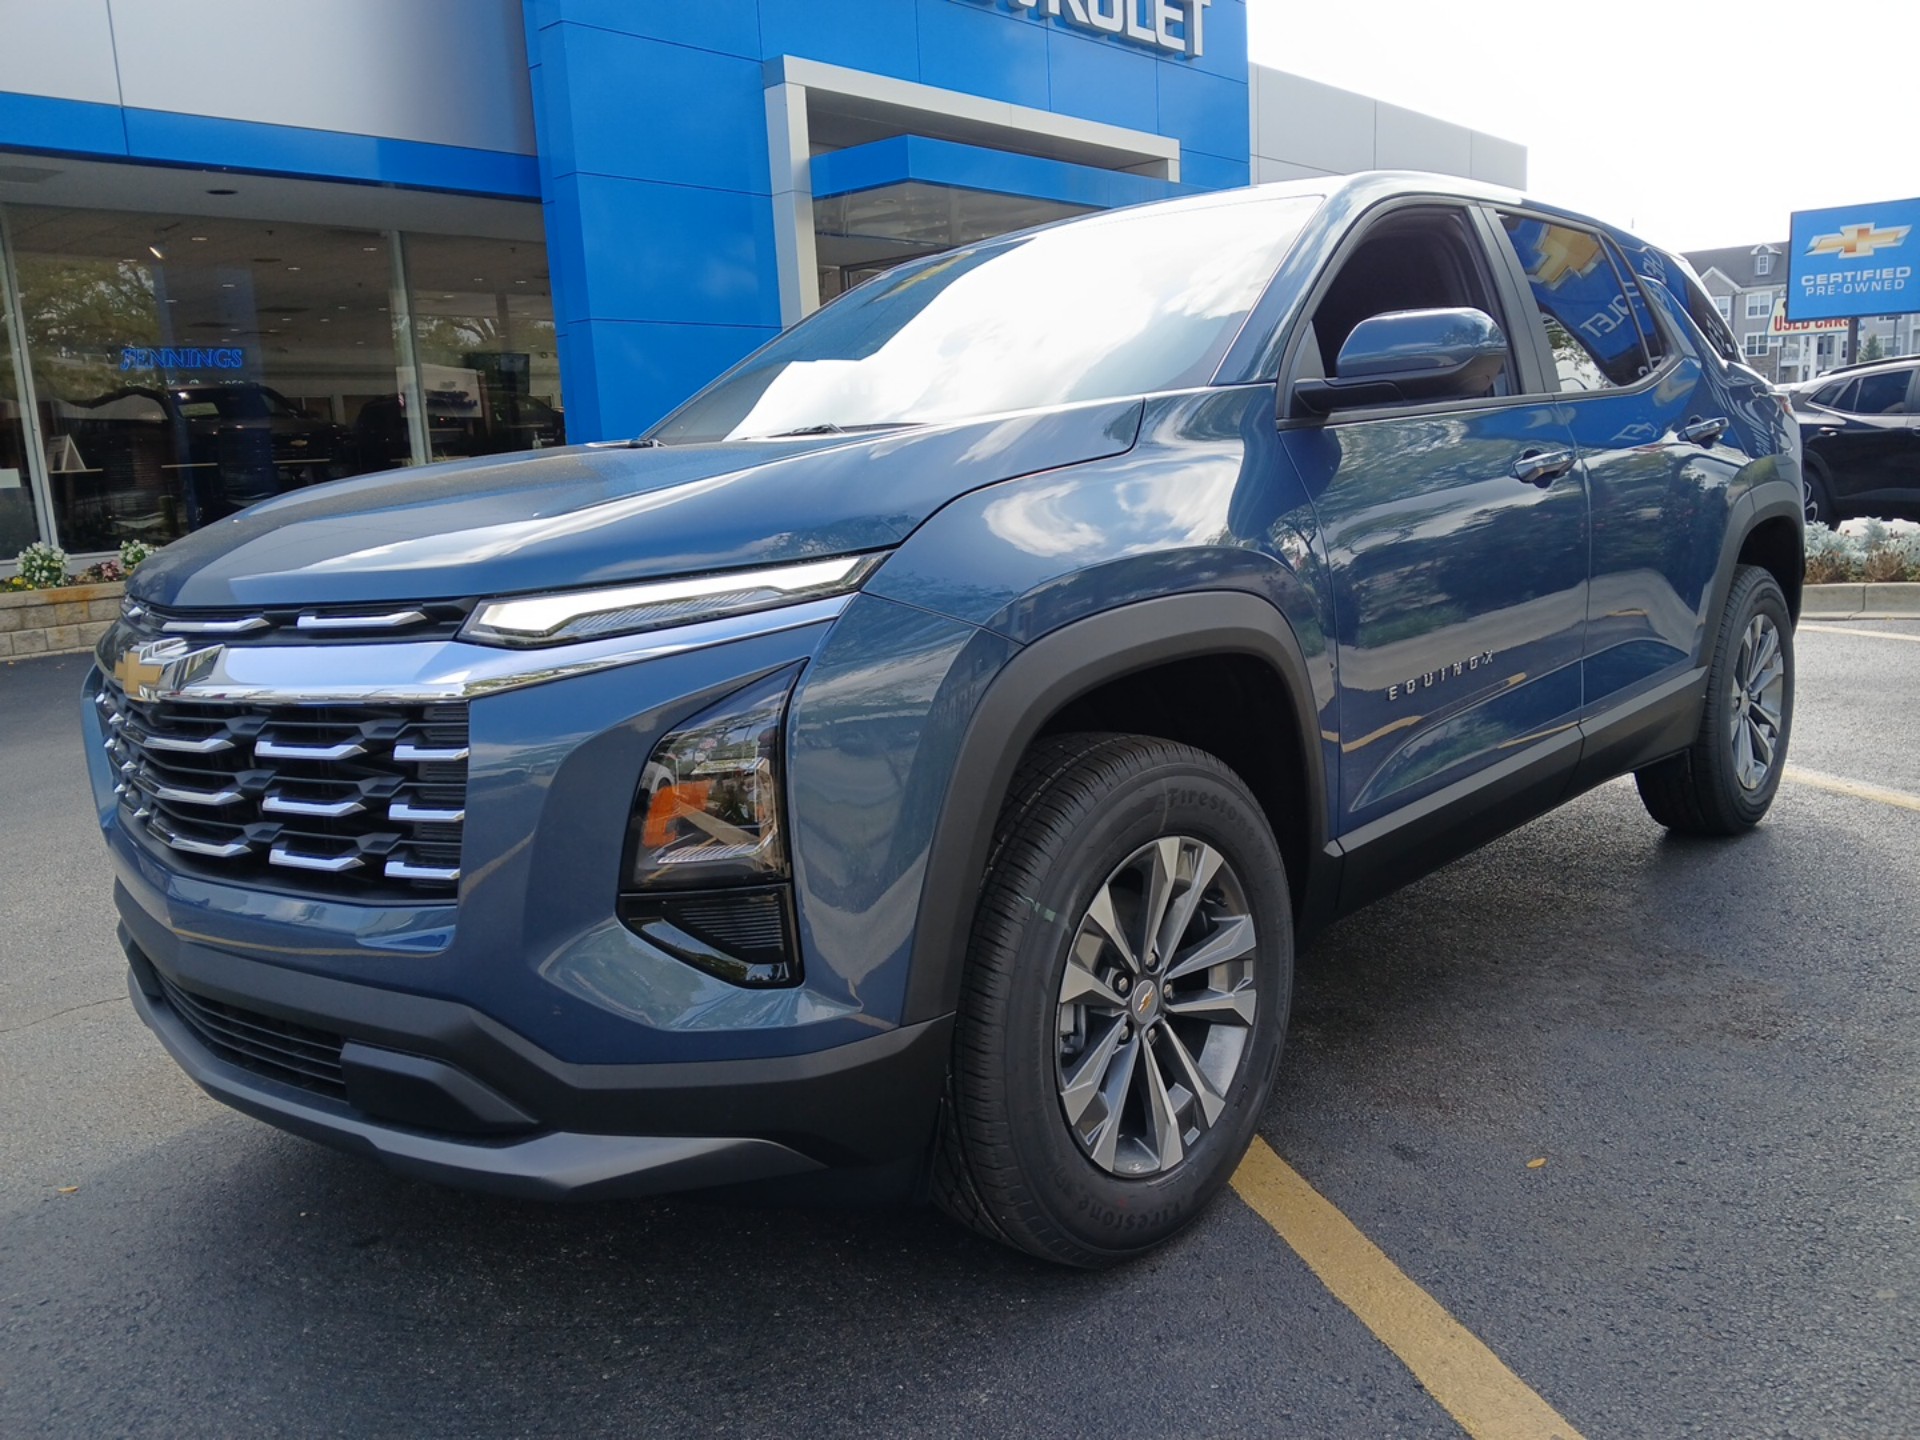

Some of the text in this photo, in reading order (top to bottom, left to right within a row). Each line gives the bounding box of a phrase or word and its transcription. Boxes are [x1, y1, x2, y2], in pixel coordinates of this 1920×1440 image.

[1801, 266, 1912, 286] CERTIFIED
[1805, 279, 1905, 297] PRE-OWNED
[120, 347, 243, 370] JENNINGS
[1388, 650, 1493, 701] EQUINOX
[1168, 788, 1255, 841] Firestone
